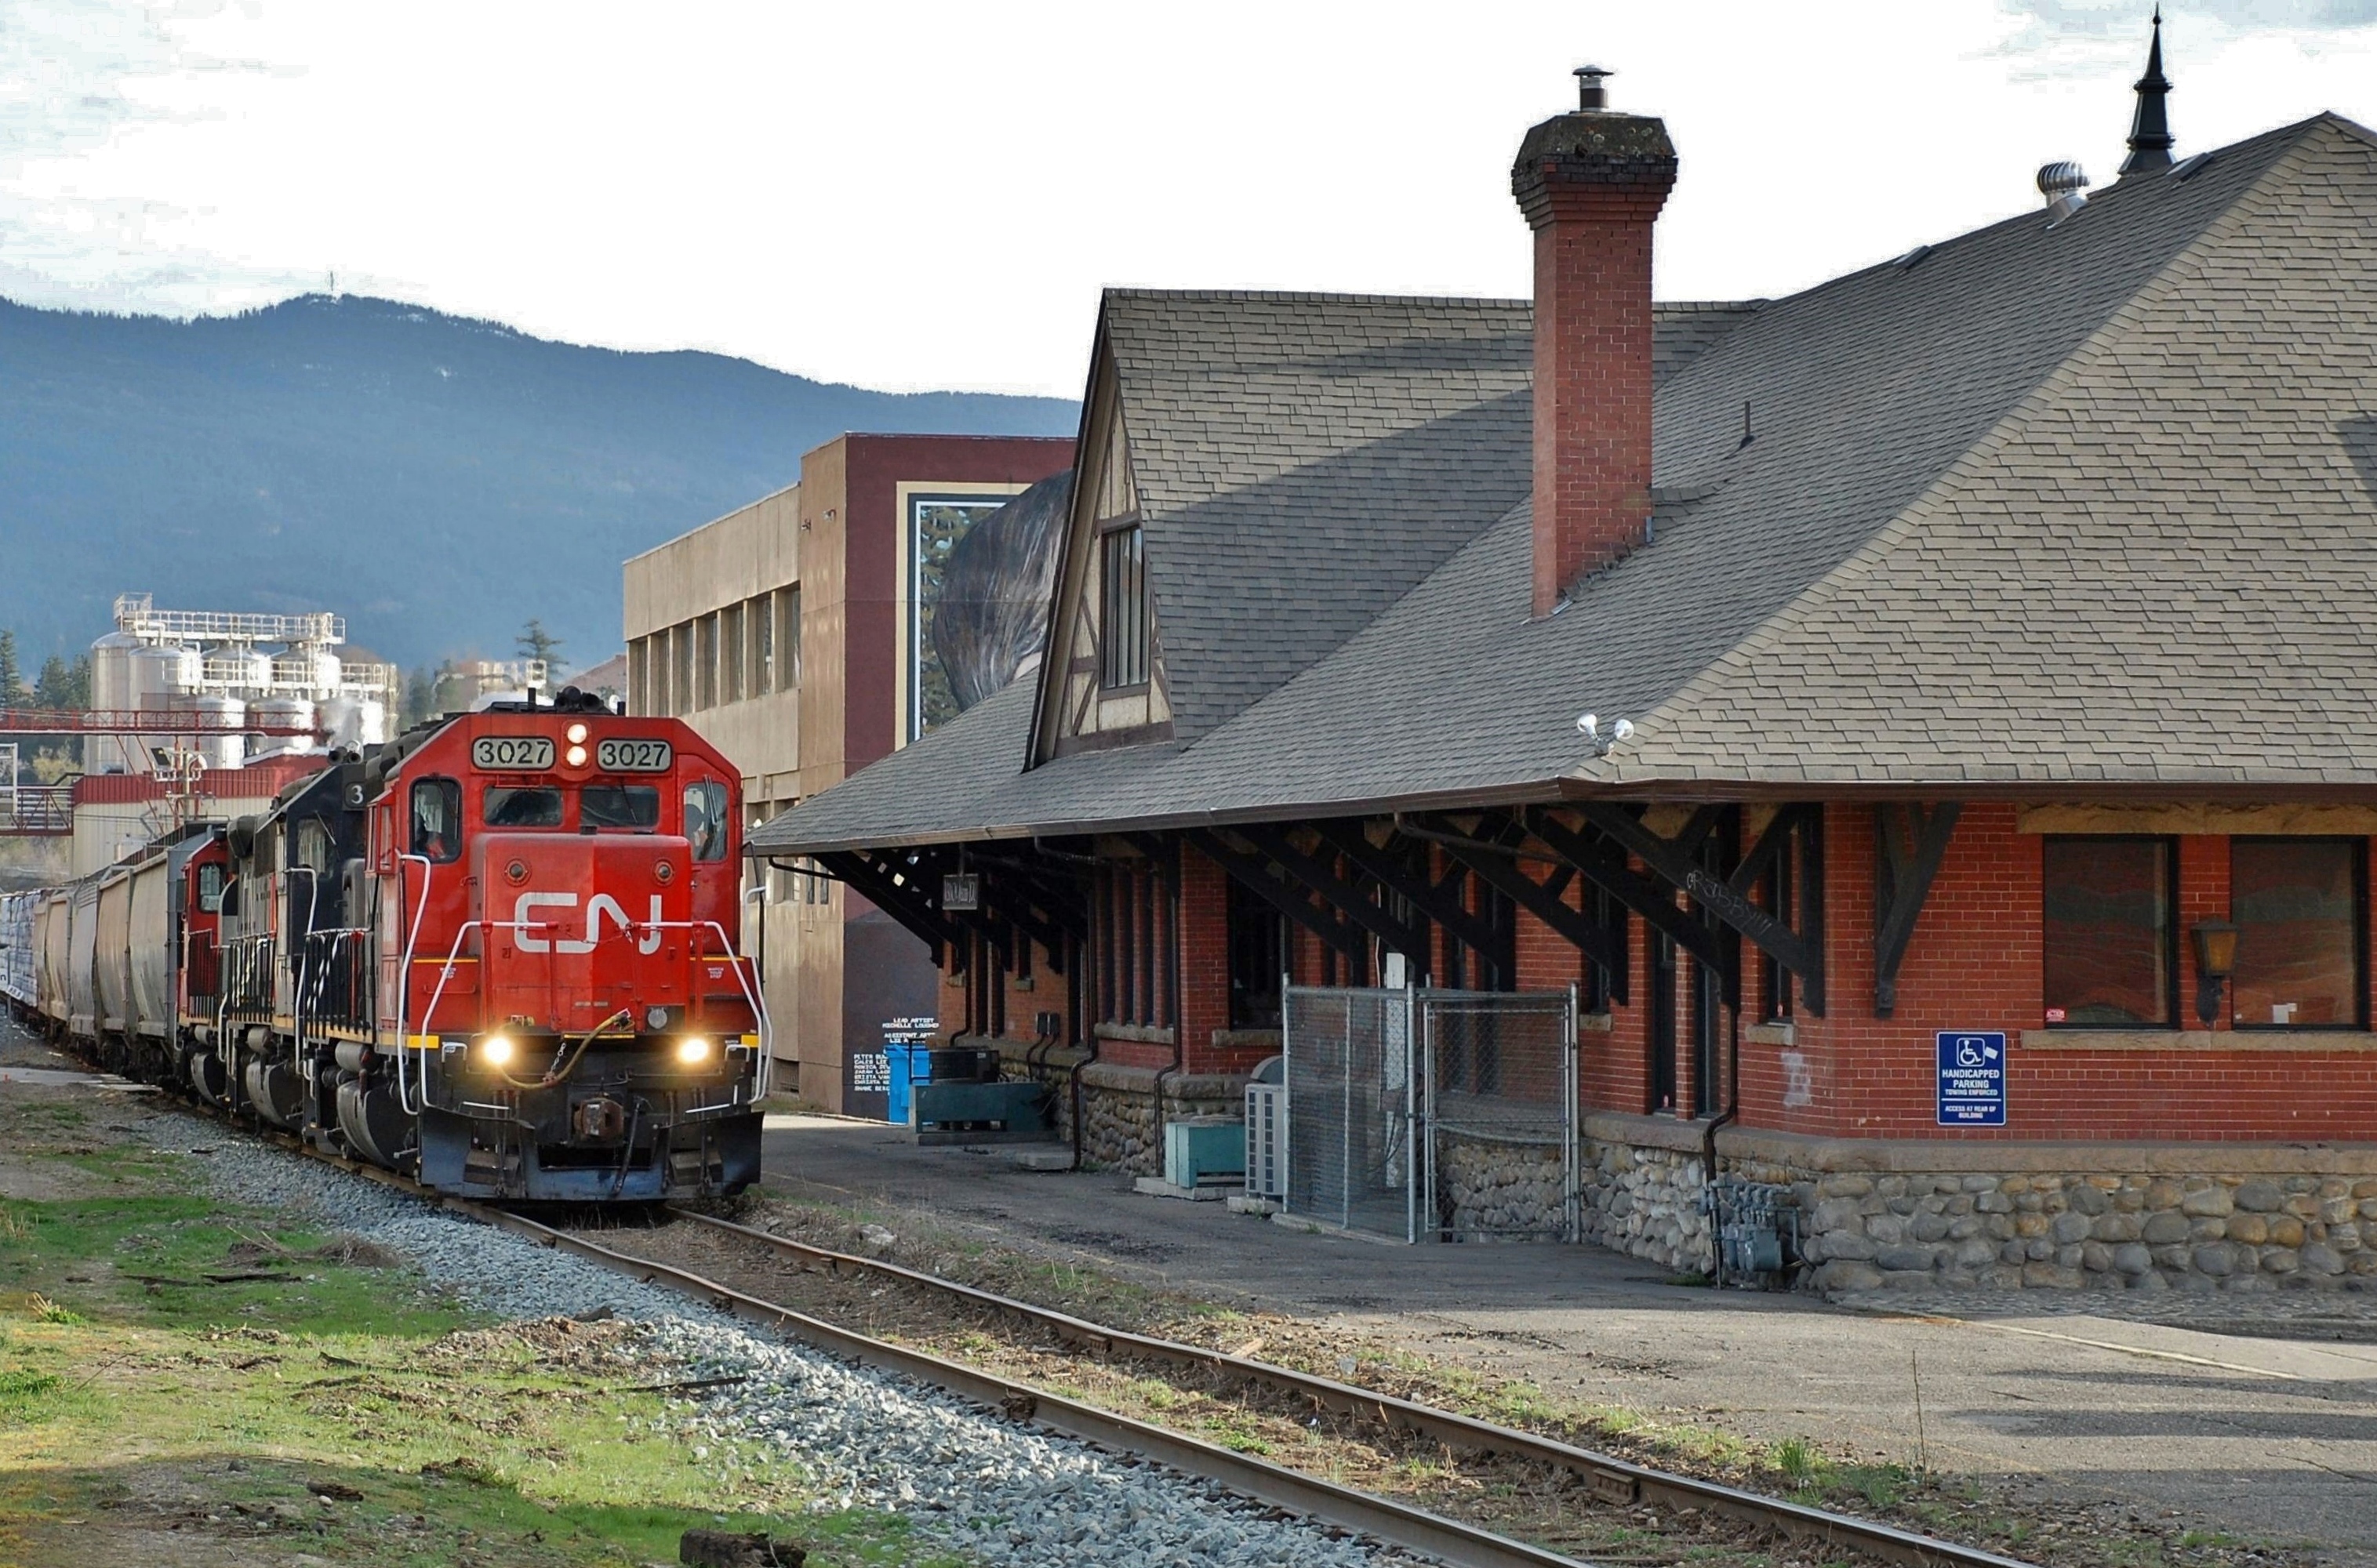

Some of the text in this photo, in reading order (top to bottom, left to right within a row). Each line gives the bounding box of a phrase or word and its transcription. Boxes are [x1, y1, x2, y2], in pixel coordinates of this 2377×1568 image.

[478, 741, 549, 764] 3027
[602, 743, 667, 767] 3027
[514, 891, 662, 955] CN
[1942, 1069, 2000, 1078] HANDICAPPED
[1953, 1080, 1990, 1088] PARKING
